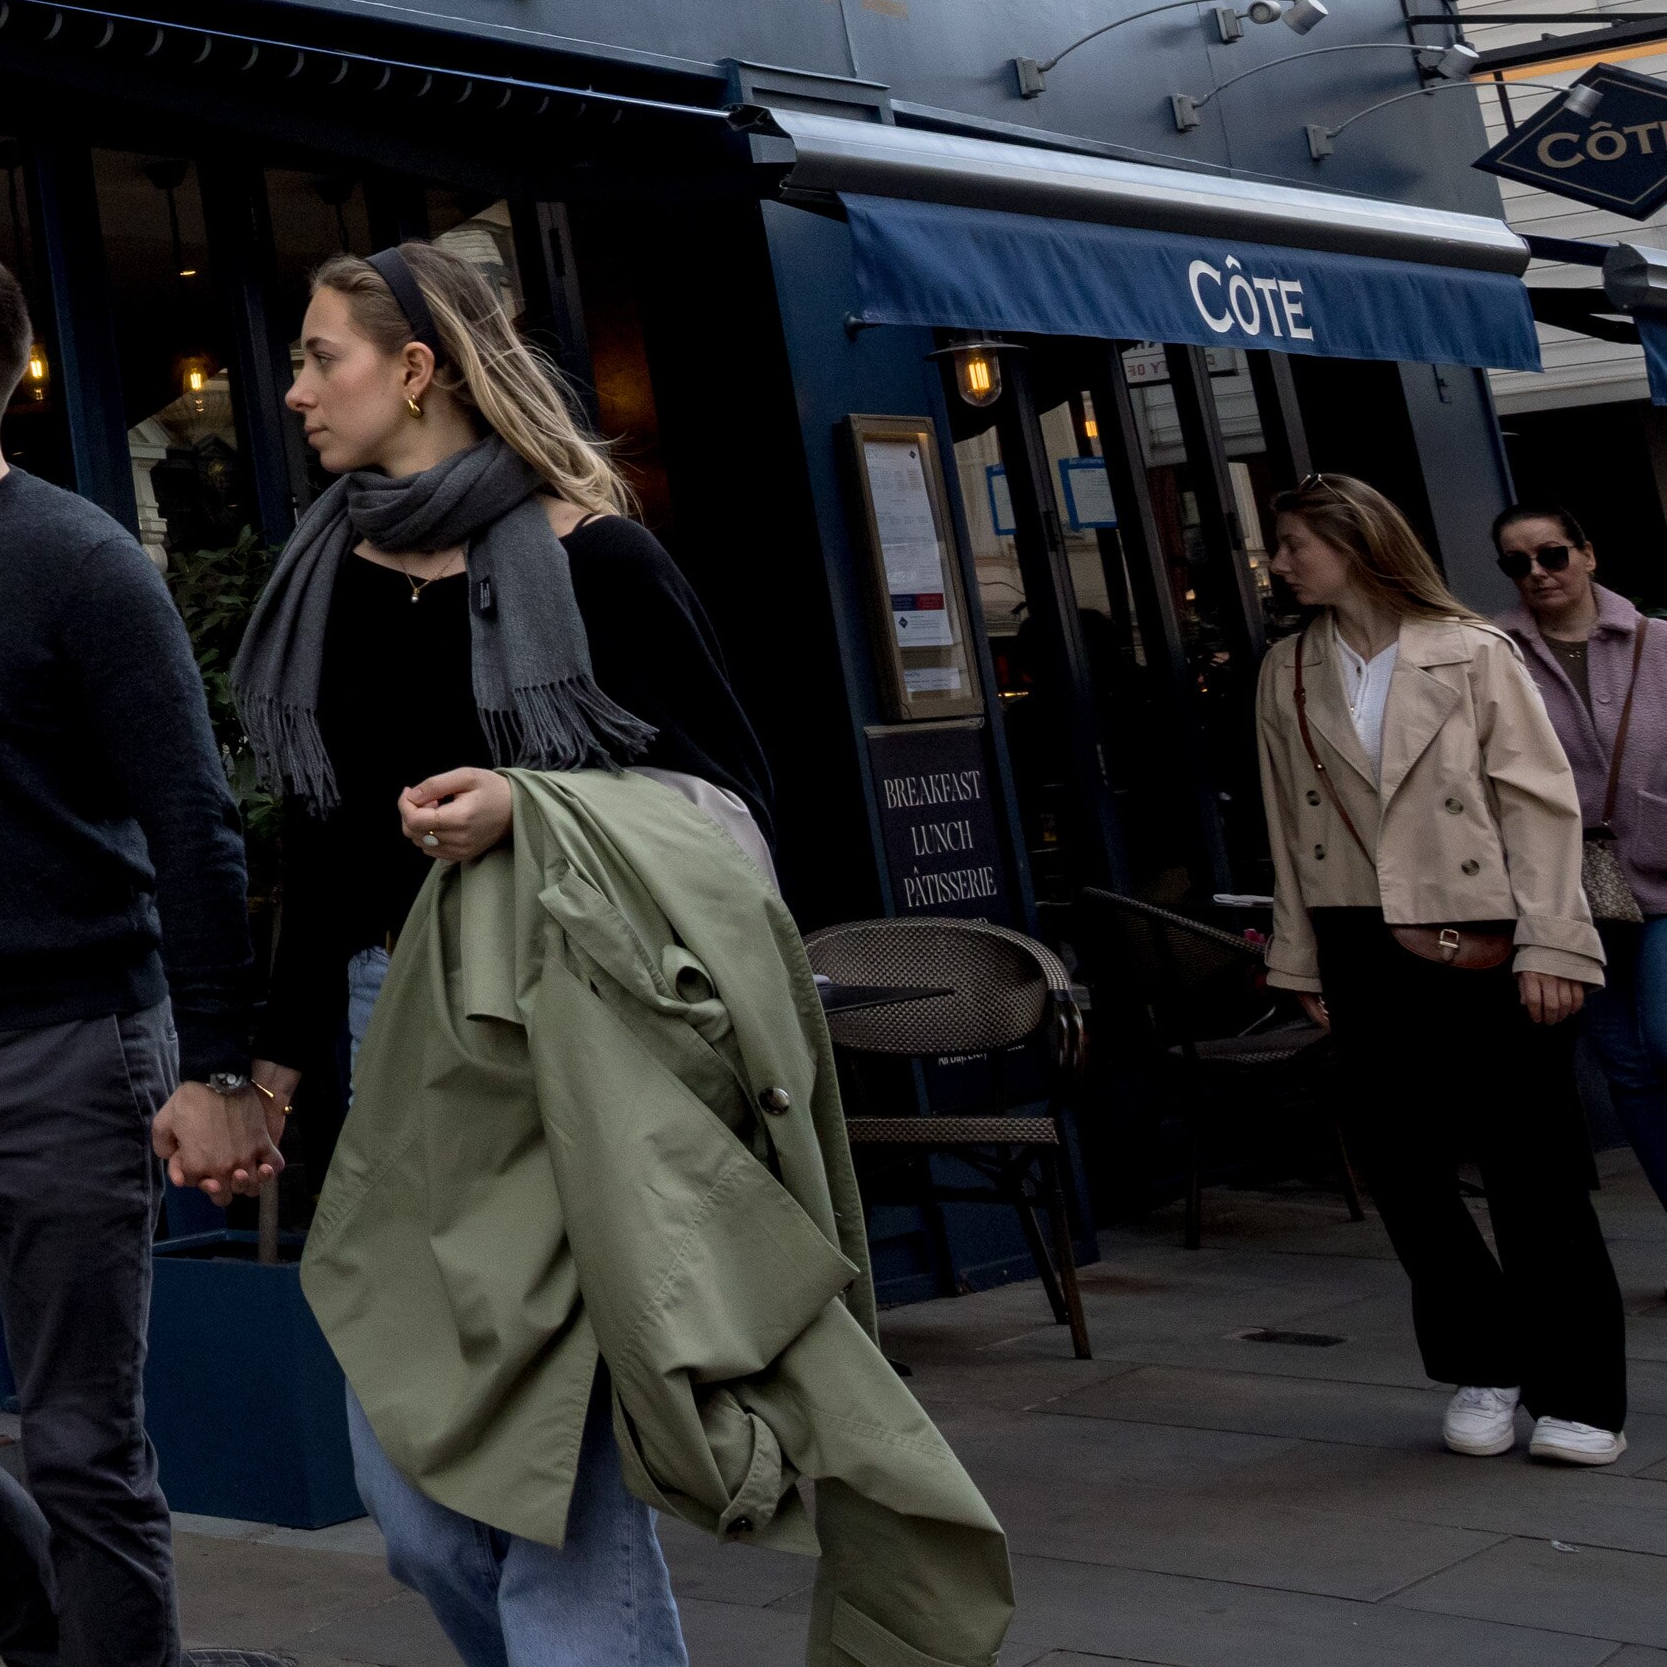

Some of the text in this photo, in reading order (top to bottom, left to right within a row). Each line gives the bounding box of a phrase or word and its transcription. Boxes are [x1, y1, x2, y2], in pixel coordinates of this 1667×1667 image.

[1537, 121, 1667, 169] CÔT
[1188, 254, 1314, 341] CÔTE
[883, 770, 981, 809] BREAKFAST
[911, 819, 975, 856] LUNCH
[904, 865, 998, 908] PÂTISSERIE
